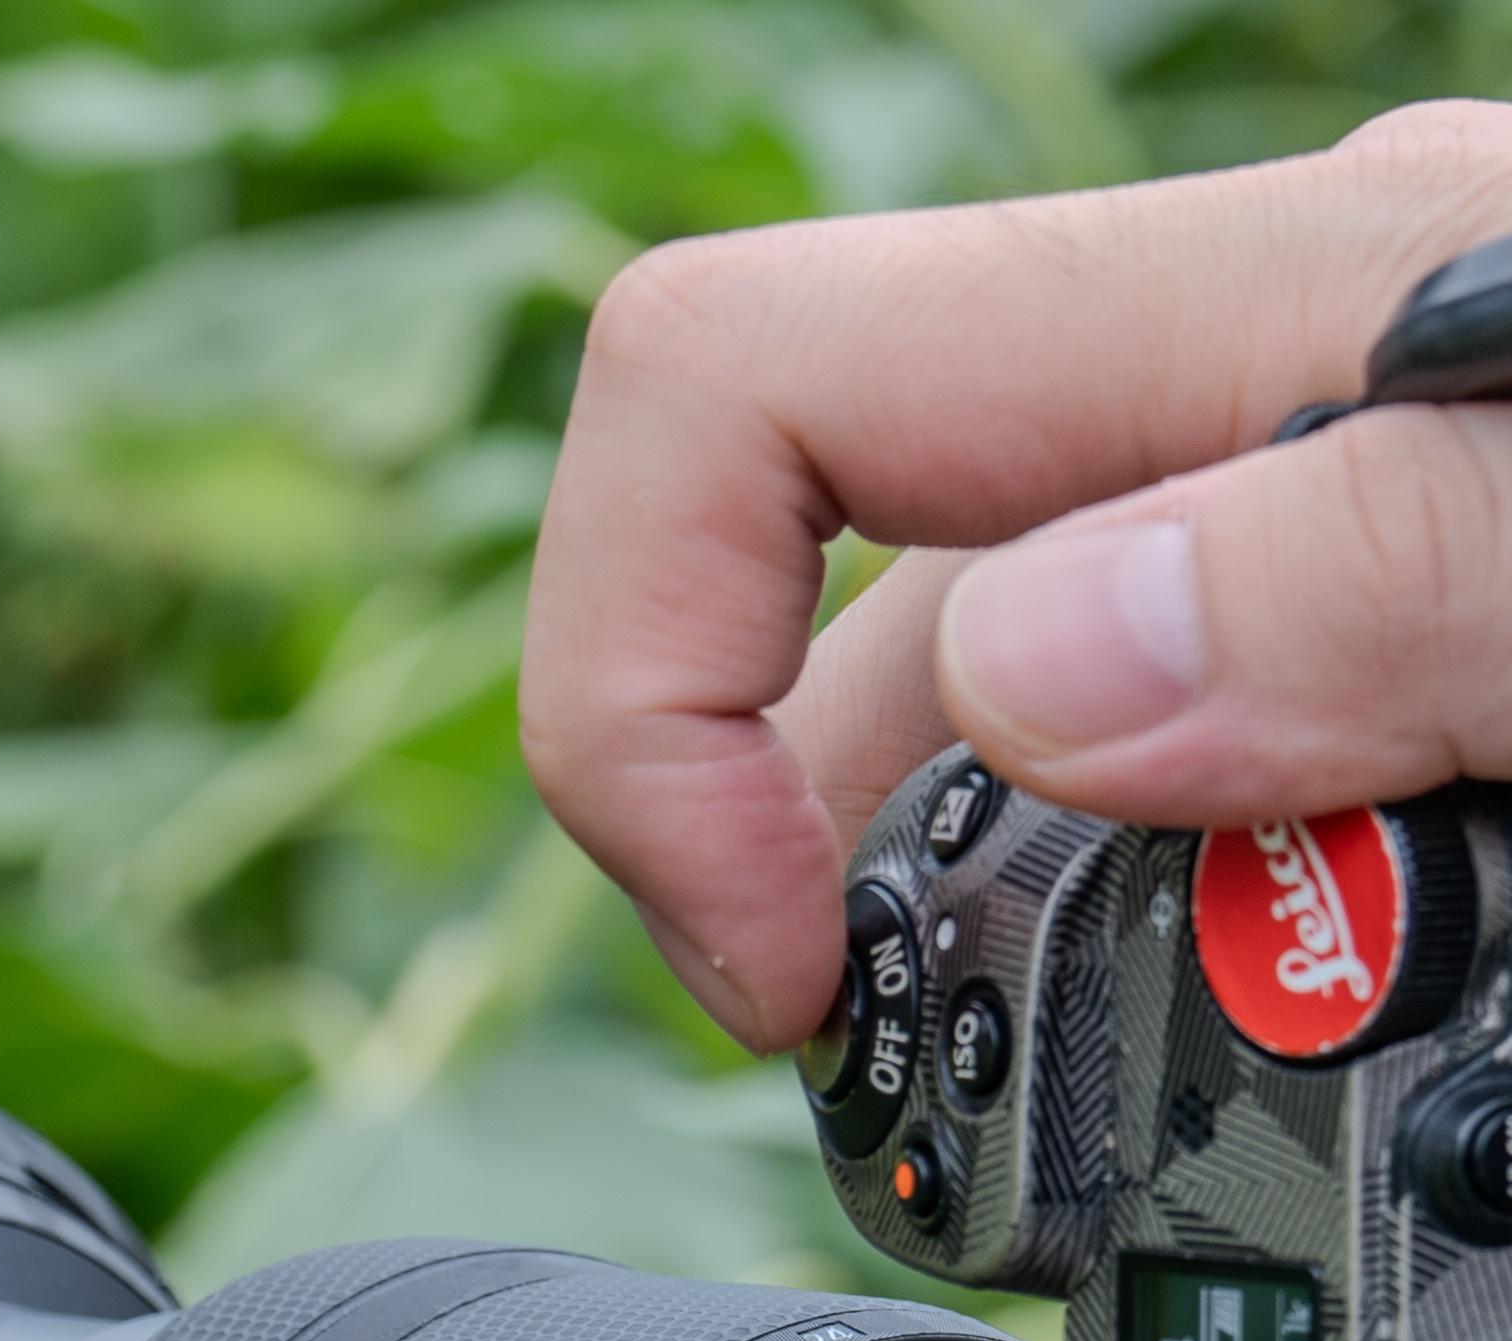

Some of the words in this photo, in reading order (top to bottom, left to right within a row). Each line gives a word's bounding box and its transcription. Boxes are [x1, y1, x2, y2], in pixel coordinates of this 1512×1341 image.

[871, 935, 910, 995] ON
[869, 1016, 910, 1095] OFF
[953, 1011, 978, 1081] ISO
